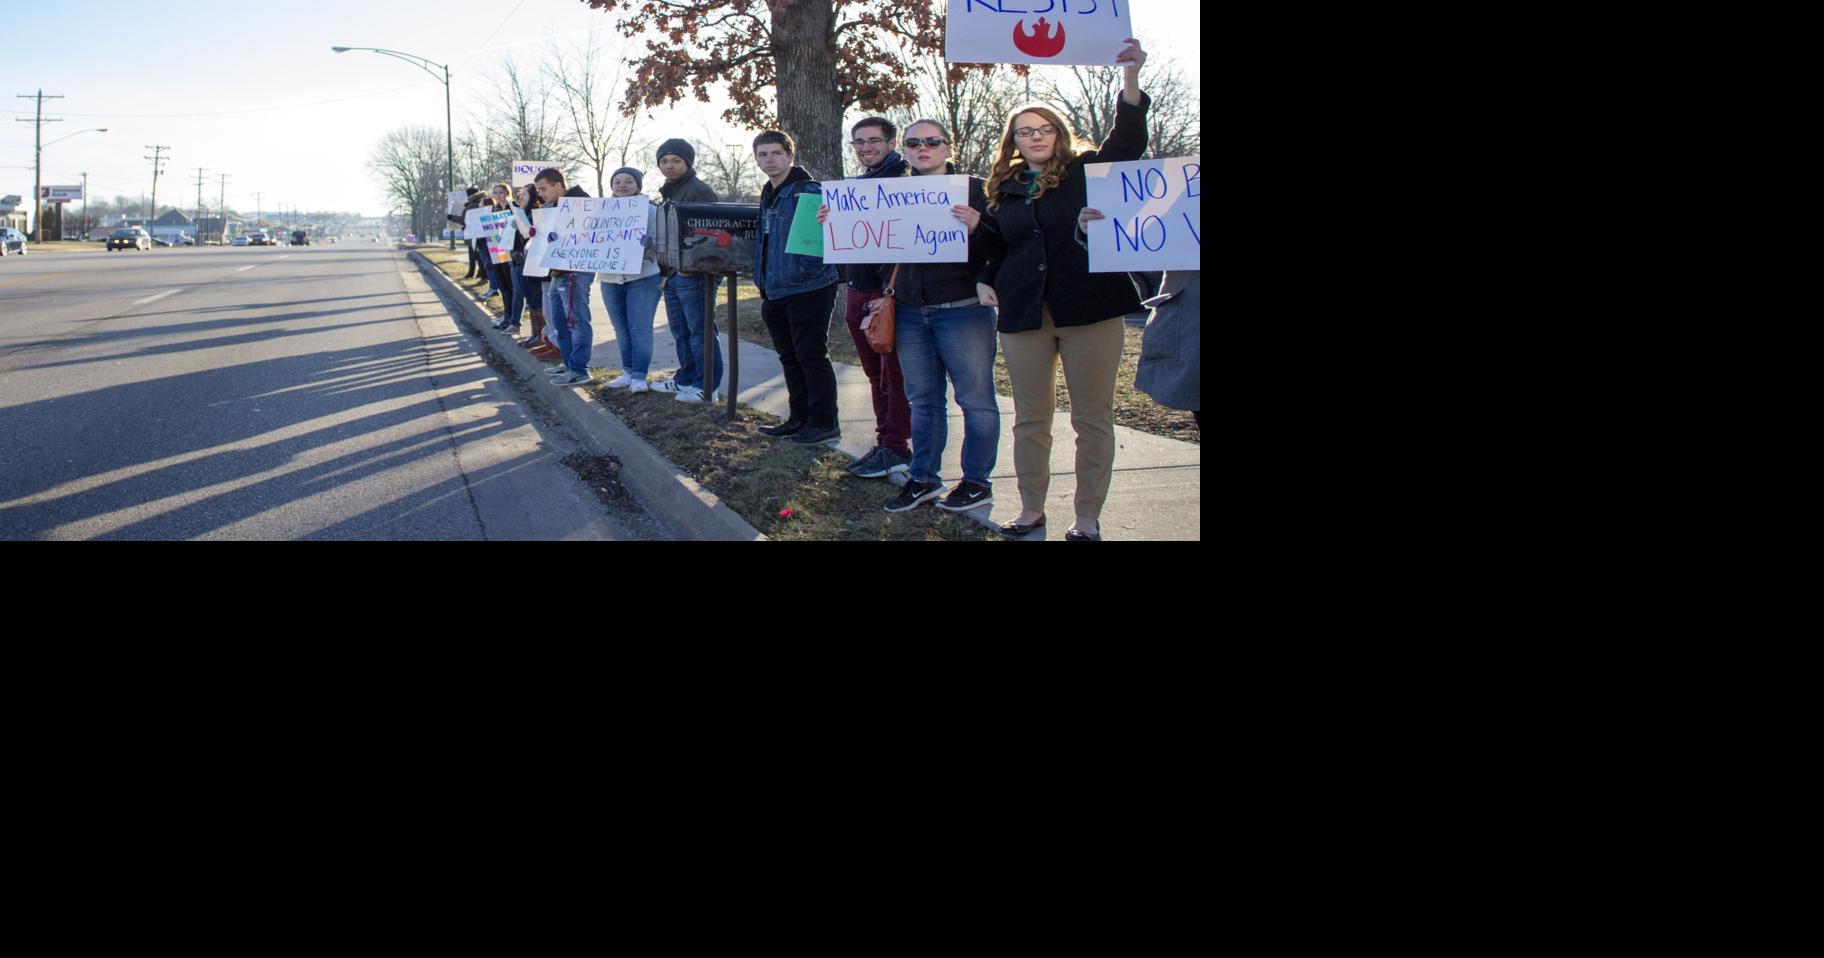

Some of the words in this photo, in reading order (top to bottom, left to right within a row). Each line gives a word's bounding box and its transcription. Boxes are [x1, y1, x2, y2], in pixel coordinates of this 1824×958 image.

[1121, 167, 1167, 203] NO
[628, 198, 640, 208] IS
[877, 184, 950, 209] America
[566, 218, 575, 229] A
[583, 217, 625, 230] COUNTRY
[625, 215, 641, 227] OF
[1113, 215, 1166, 252] NO
[561, 227, 645, 247] IMMIGRANTS
[829, 218, 905, 251] LOVE
[914, 224, 966, 255] Again
[551, 248, 599, 259] EVERYONE
[606, 247, 620, 259] IS
